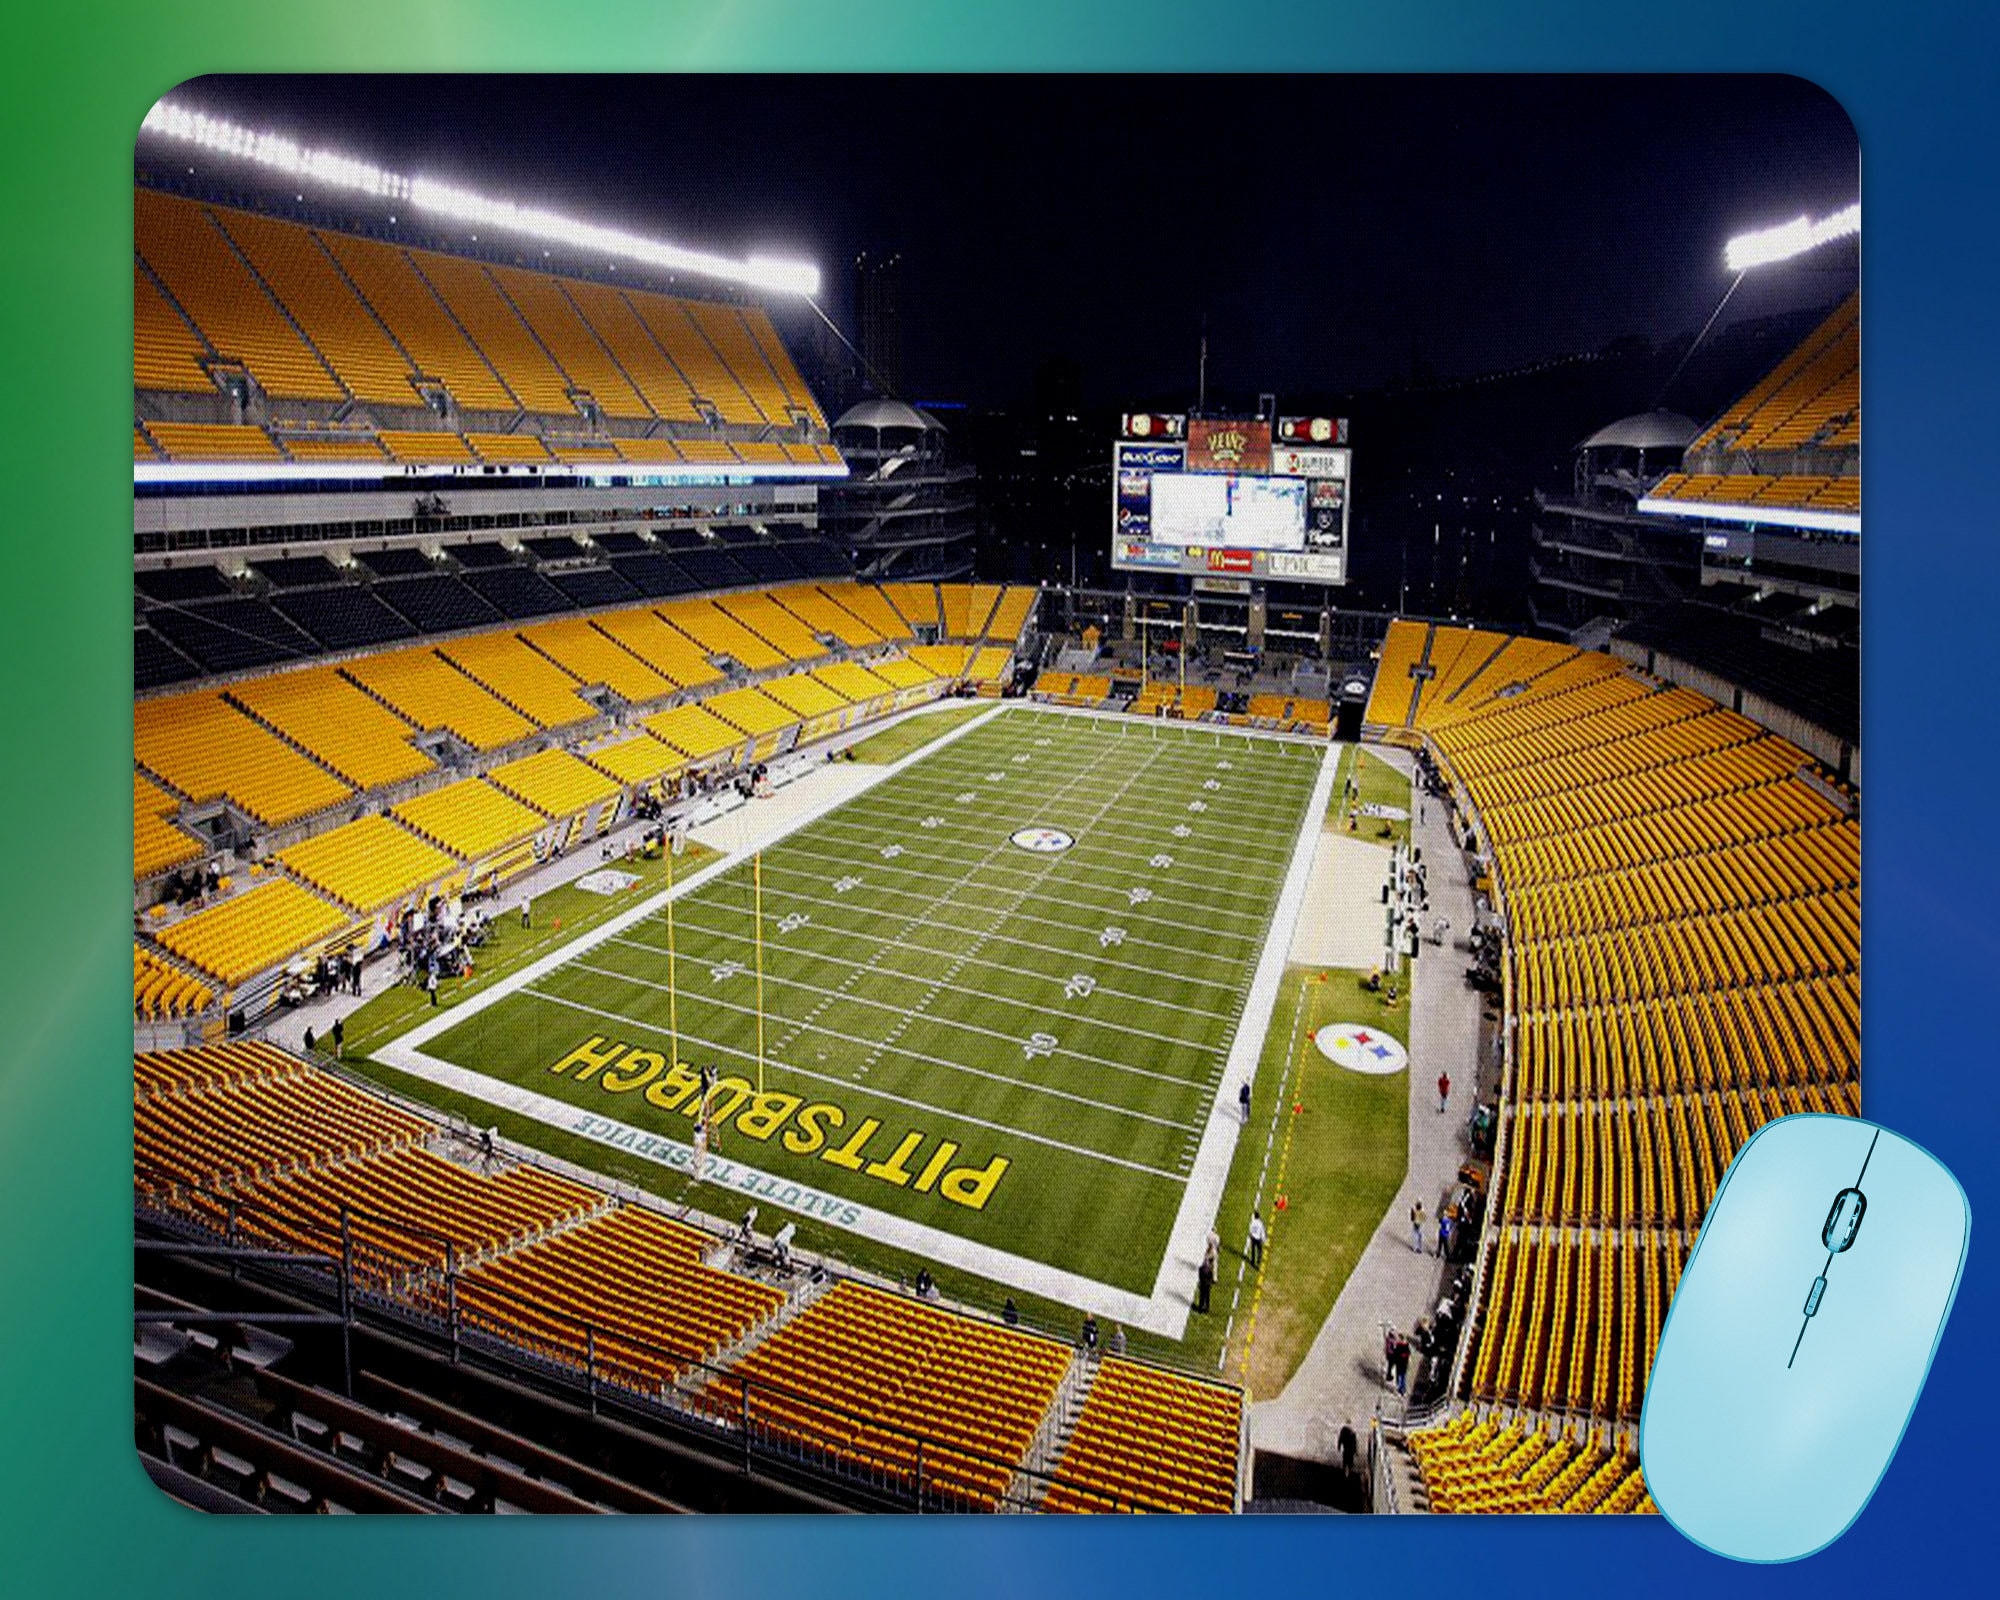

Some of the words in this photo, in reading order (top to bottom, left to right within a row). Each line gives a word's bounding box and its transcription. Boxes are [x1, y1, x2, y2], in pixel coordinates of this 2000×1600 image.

[550, 1034, 1012, 1211] PITTSBURGH
[573, 1114, 692, 1167] SERVICE
[739, 1172, 861, 1227] SALUTE
